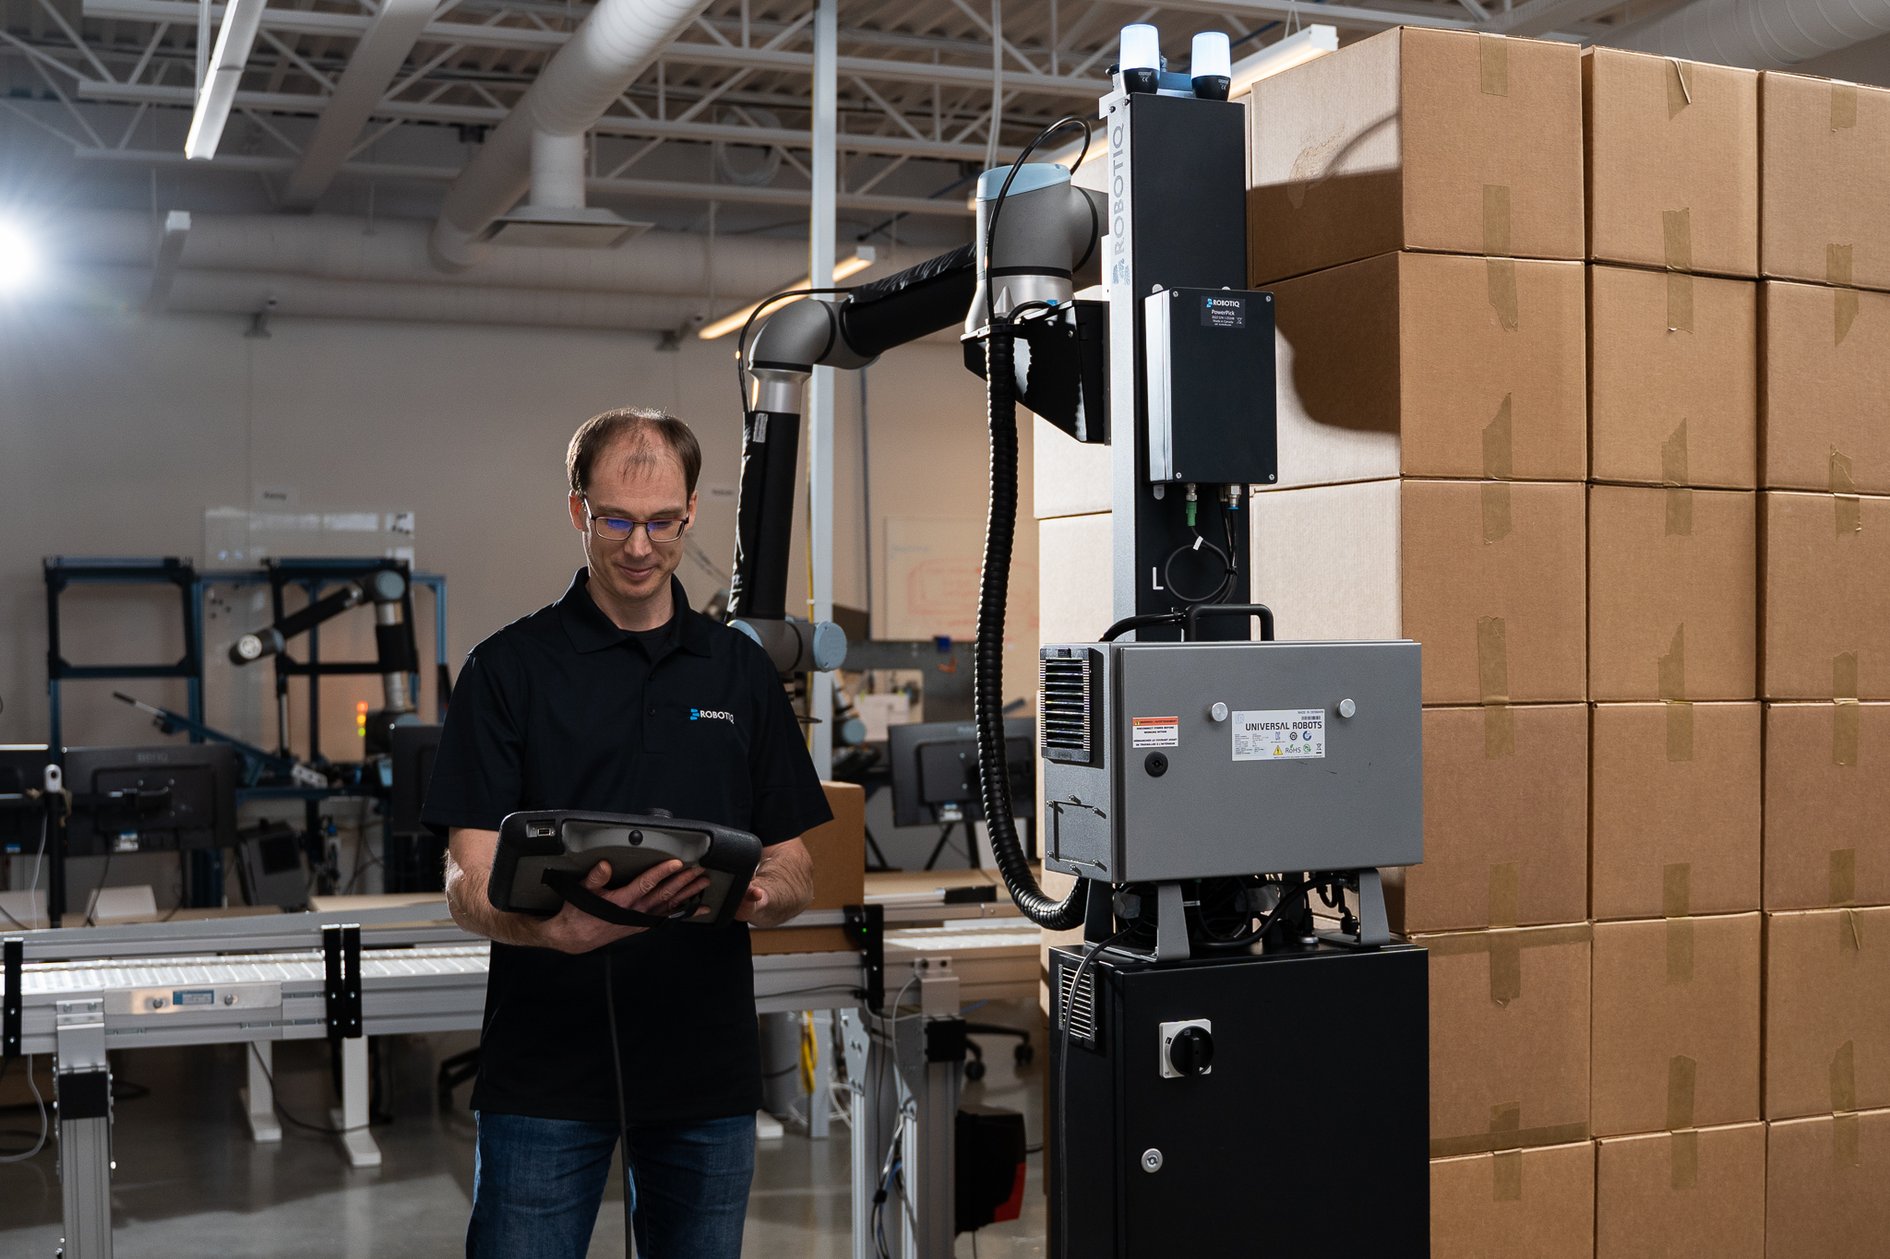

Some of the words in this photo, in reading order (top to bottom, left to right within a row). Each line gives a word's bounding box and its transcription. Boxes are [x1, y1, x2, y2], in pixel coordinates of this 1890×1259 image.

[1112, 123, 1125, 256] ROBOTIQ
[1213, 300, 1240, 308] ROBOTIQ
[1152, 566, 1164, 590] L
[700, 710, 734, 724] ROBOTQ
[1245, 722, 1290, 731] UNIVERSAL
[1292, 721, 1323, 730] ROBOTS
